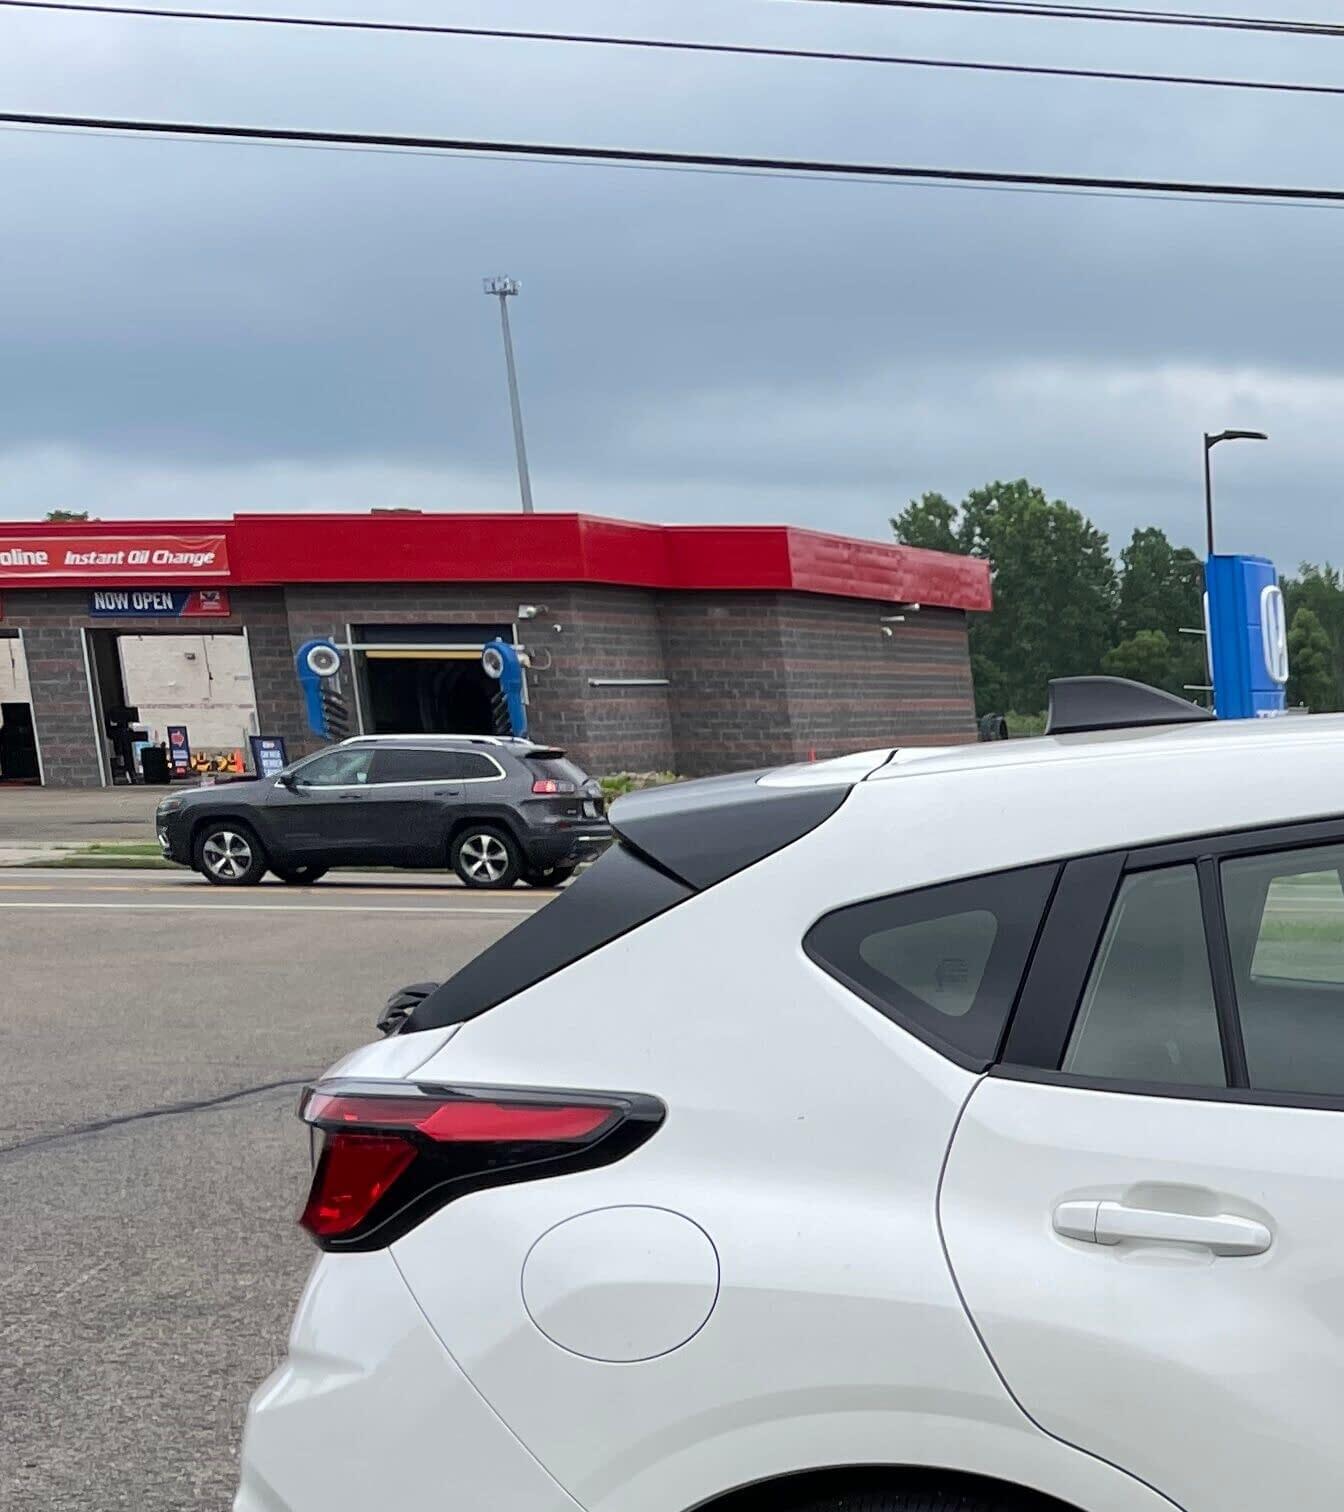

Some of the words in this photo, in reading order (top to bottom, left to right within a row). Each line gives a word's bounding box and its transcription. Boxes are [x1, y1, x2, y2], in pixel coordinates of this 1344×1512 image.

[64, 550, 125, 565] Instant
[128, 550, 150, 564] Oil
[152, 550, 215, 567] Change
[94, 592, 128, 609] NOW
[133, 592, 173, 610] OPEN
